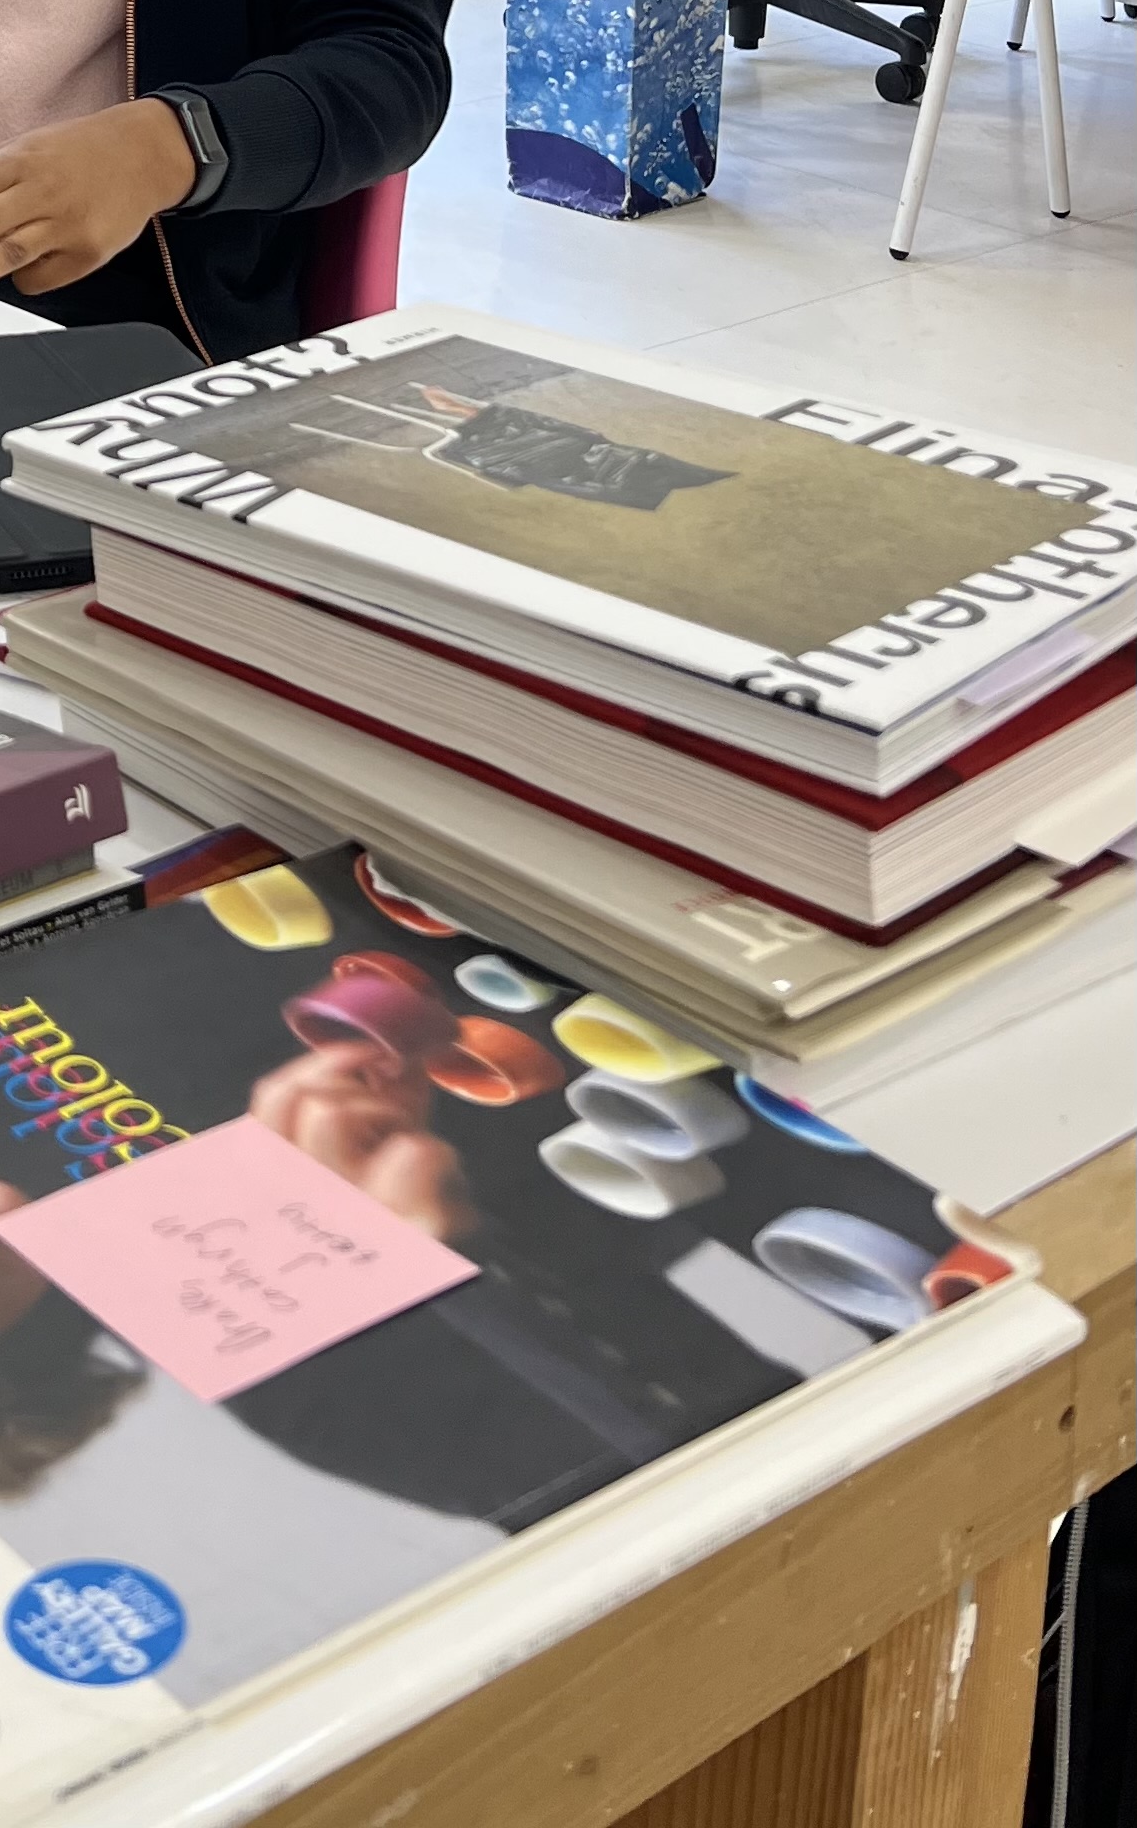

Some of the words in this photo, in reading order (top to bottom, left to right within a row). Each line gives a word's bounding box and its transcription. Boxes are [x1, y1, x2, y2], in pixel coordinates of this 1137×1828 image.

[121, 333, 371, 422] not?
[28, 415, 290, 525] Why
[760, 398, 1110, 505] Elina
[728, 499, 1137, 714] otherus
